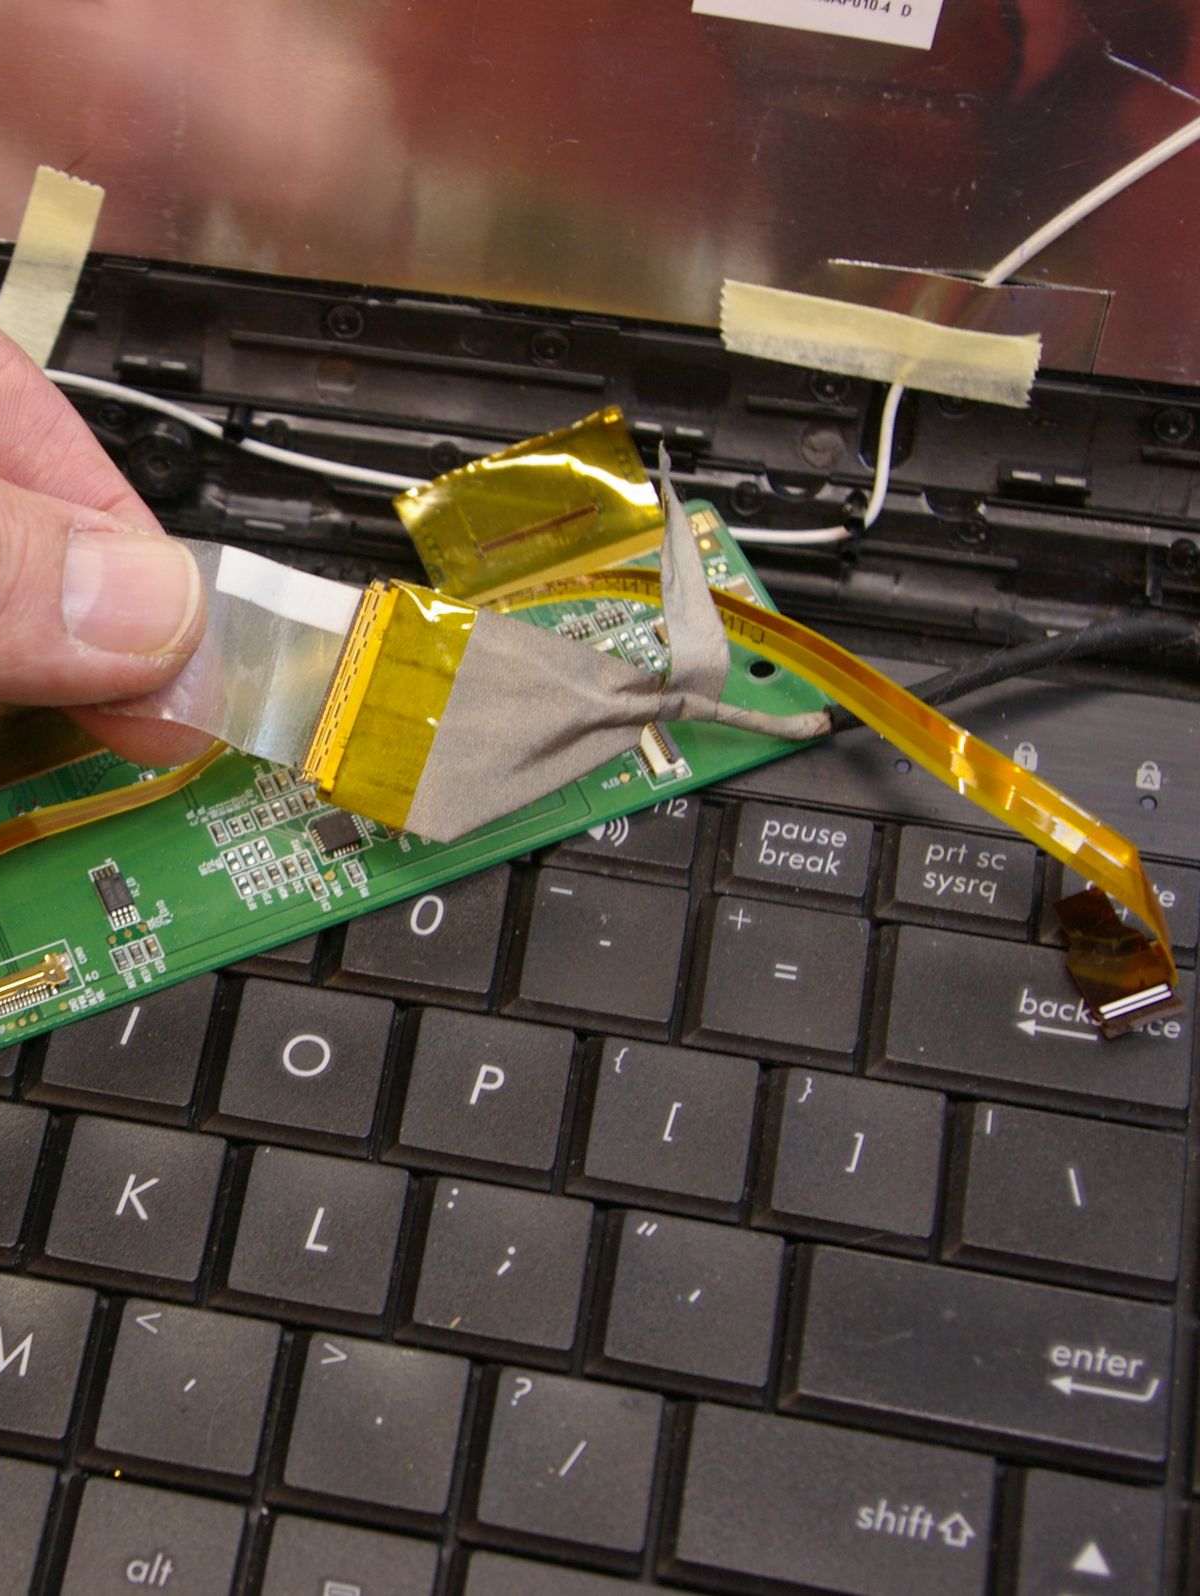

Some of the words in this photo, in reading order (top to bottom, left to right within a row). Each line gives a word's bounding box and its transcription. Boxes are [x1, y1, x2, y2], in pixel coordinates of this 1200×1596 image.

[901, 4, 912, 17] D
[760, 817, 848, 851] pause
[758, 840, 842, 877] break
[924, 839, 968, 868] prt
[976, 851, 1007, 871] sc
[922, 870, 998, 904] sysrq
[728, 908, 752, 930] +
[774, 962, 798, 981] =
[119, 1006, 141, 1046] I
[1018, 988, 1181, 1039] backce
[281, 1033, 332, 1078] O
[614, 1047, 629, 1074] {
[468, 1063, 505, 1106] P
[797, 1076, 813, 1103] }
[662, 1101, 682, 1143] [
[845, 1132, 865, 1173] ]
[115, 1173, 160, 1221] K
[303, 1206, 329, 1253] L
[496, 1246, 516, 1276] ;
[135, 1312, 162, 1334] <
[320, 1342, 348, 1365] >
[1049, 1344, 1143, 1379] enter
[511, 1377, 533, 1406] ?
[559, 1440, 587, 1477] /
[856, 1499, 934, 1540] shift
[126, 1553, 172, 1587] alt
